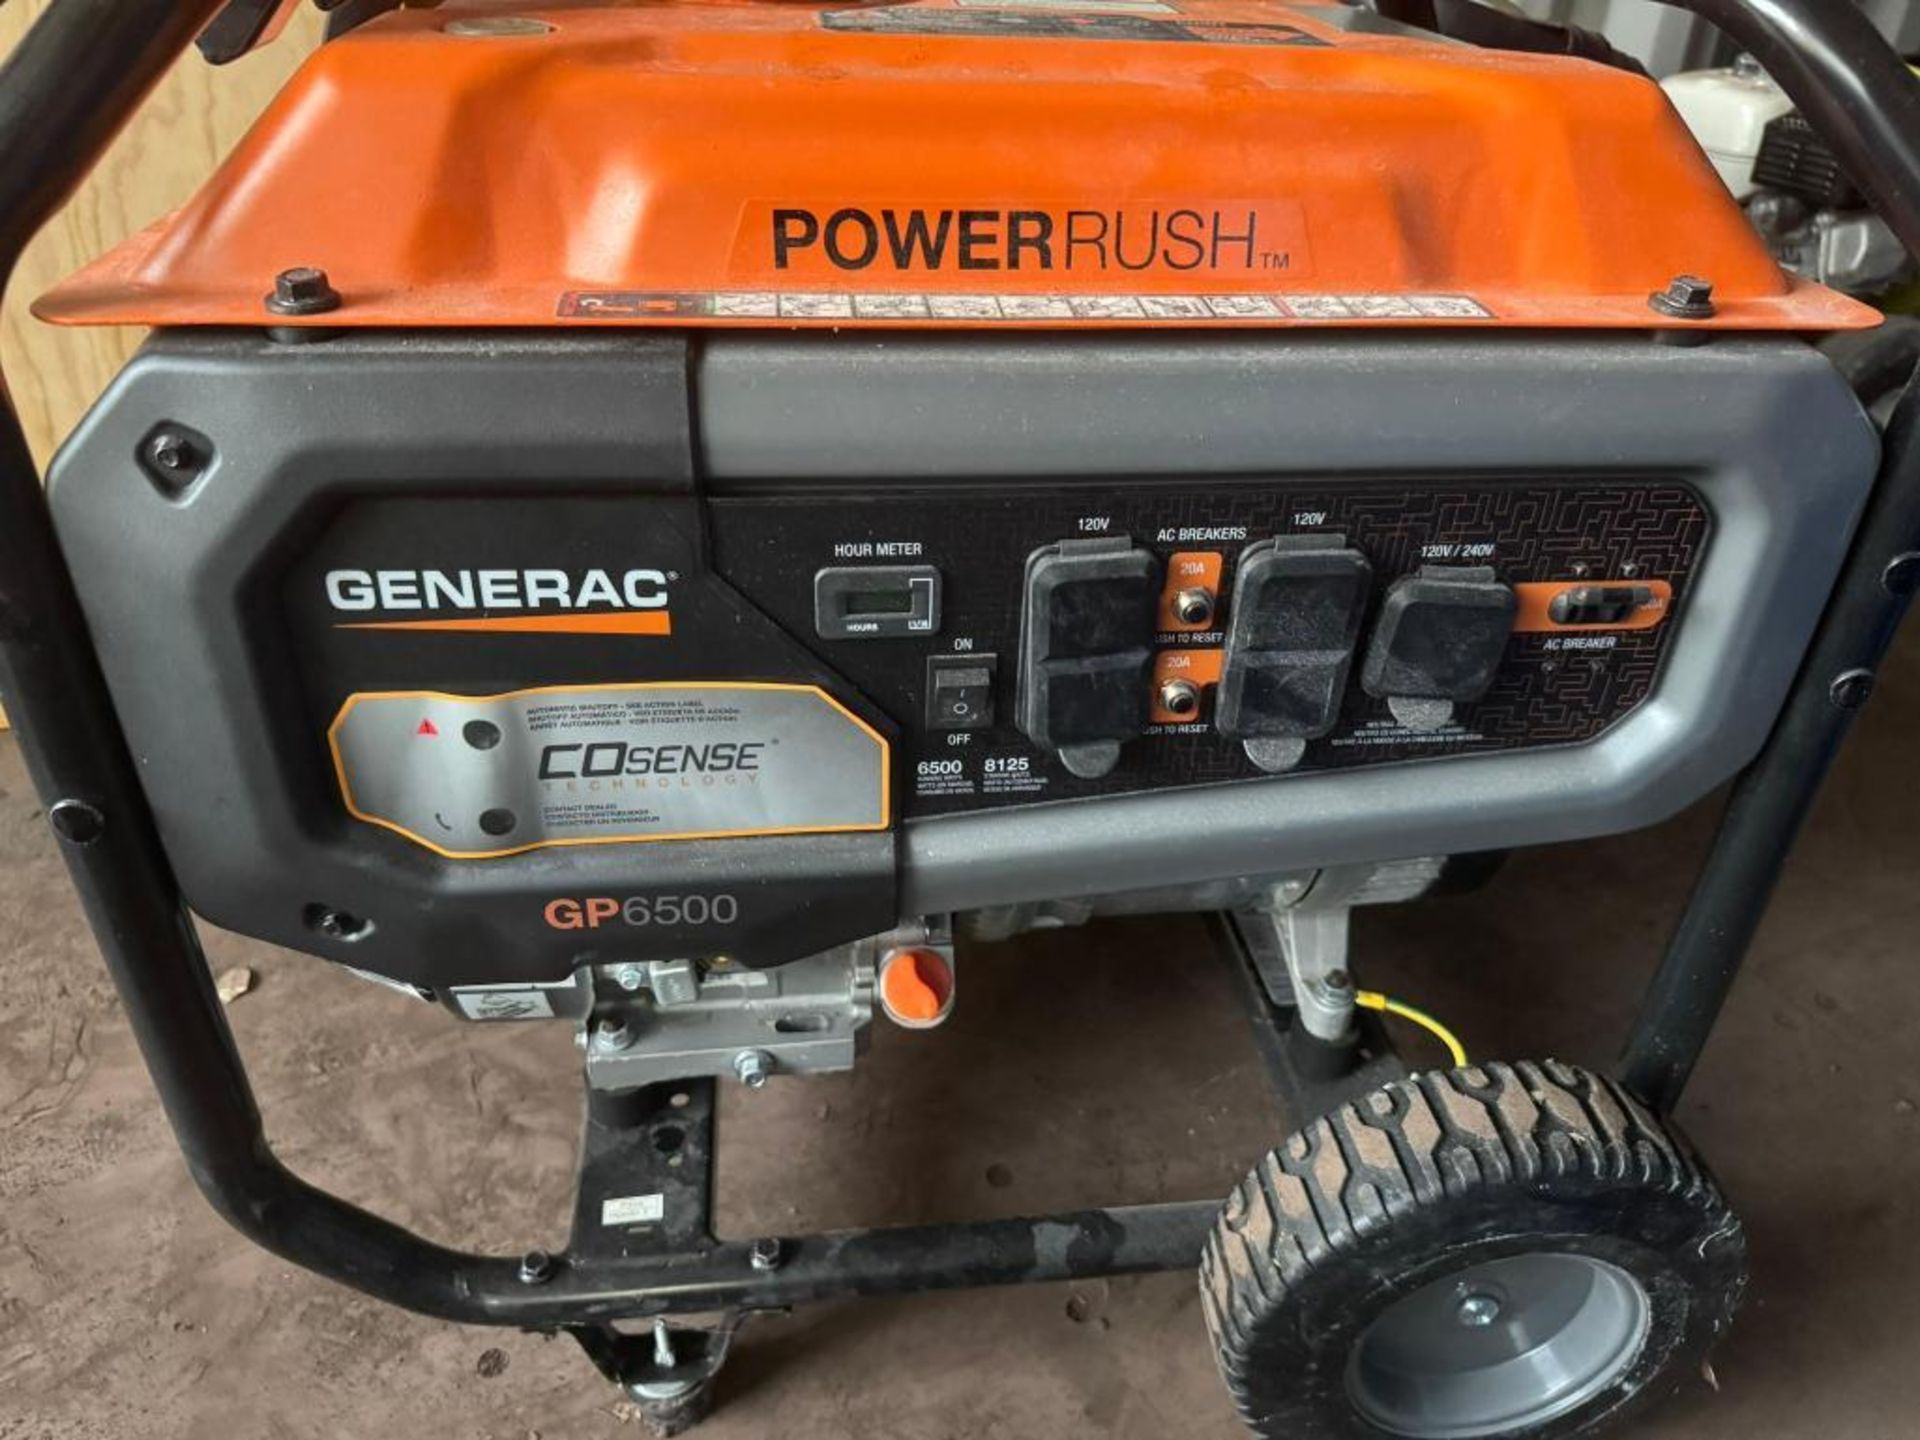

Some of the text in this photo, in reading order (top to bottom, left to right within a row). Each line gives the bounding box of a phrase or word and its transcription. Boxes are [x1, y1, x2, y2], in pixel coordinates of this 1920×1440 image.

[1078, 517, 1110, 531] 120V
[1294, 512, 1326, 526] 120V
[1157, 527, 1247, 542] AC BREAKERS
[834, 542, 922, 557] HOUR METER
[1420, 545, 1451, 558] 120V
[1462, 543, 1495, 557] 240V
[1180, 562, 1205, 575] 20A
[325, 569, 668, 610] GENERAC
[846, 623, 879, 632] HOURS
[954, 637, 973, 650] ON
[1178, 632, 1190, 643] TO
[1191, 631, 1224, 643] RESET
[1543, 636, 1617, 650] AC BREAKER
[1167, 655, 1191, 668] 20A
[1177, 723, 1208, 733] RESET
[947, 733, 971, 746] OFF
[917, 759, 963, 775] 6500
[984, 757, 1030, 773] 8125
[543, 773, 758, 793] TECHNOLOGY
[544, 894, 738, 929] GP6500
